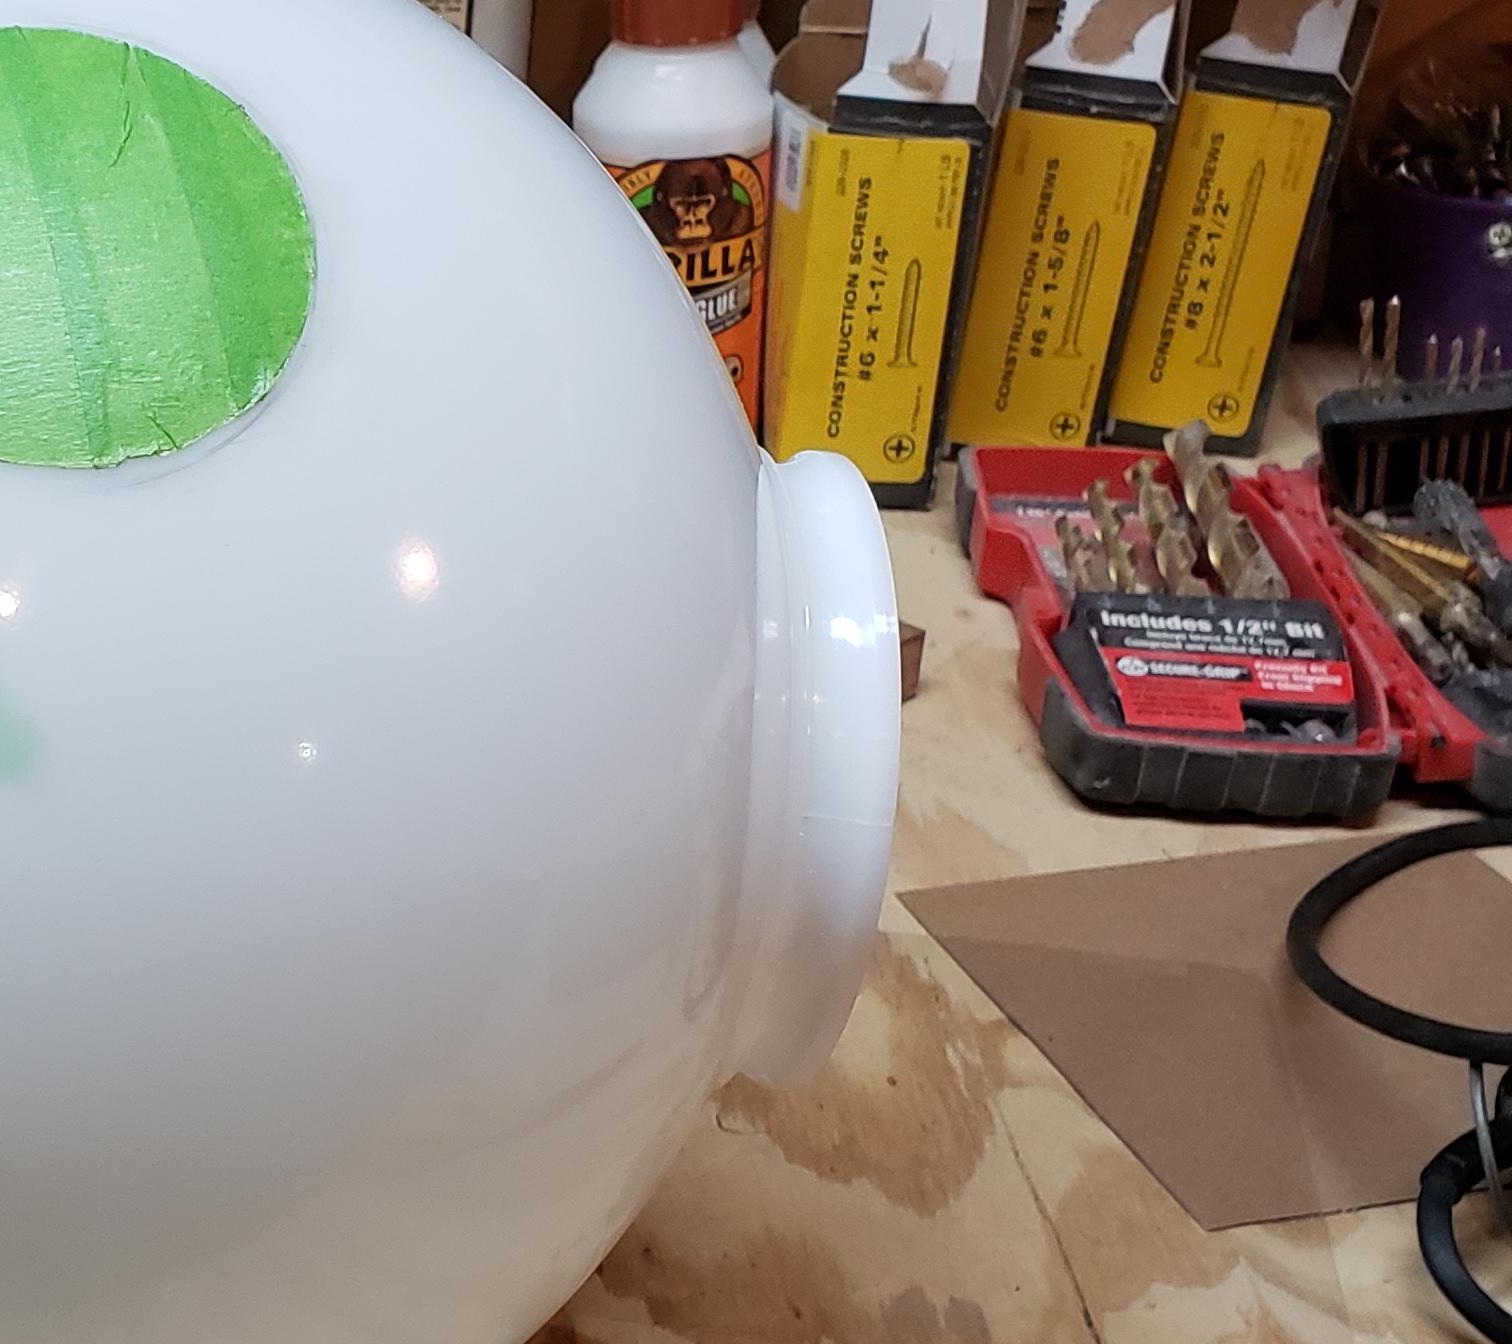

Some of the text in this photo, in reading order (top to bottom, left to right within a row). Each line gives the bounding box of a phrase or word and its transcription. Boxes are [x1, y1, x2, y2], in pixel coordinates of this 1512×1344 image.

[828, 176, 872, 438] CONSTRUCTION SCREWS
[858, 235, 889, 381] #6 x 1-1/4"
[996, 157, 1060, 412] CONSTRUCTION SCREWS
[1149, 223, 1201, 384] CONSTRUCTION
[1192, 132, 1225, 217] SCREWS
[1185, 299, 1205, 330] #8
[1197, 278, 1210, 294] x
[1030, 328, 1049, 358] #6
[1040, 305, 1053, 321] x
[1100, 609, 1326, 640] Includes 1/2" Bit
